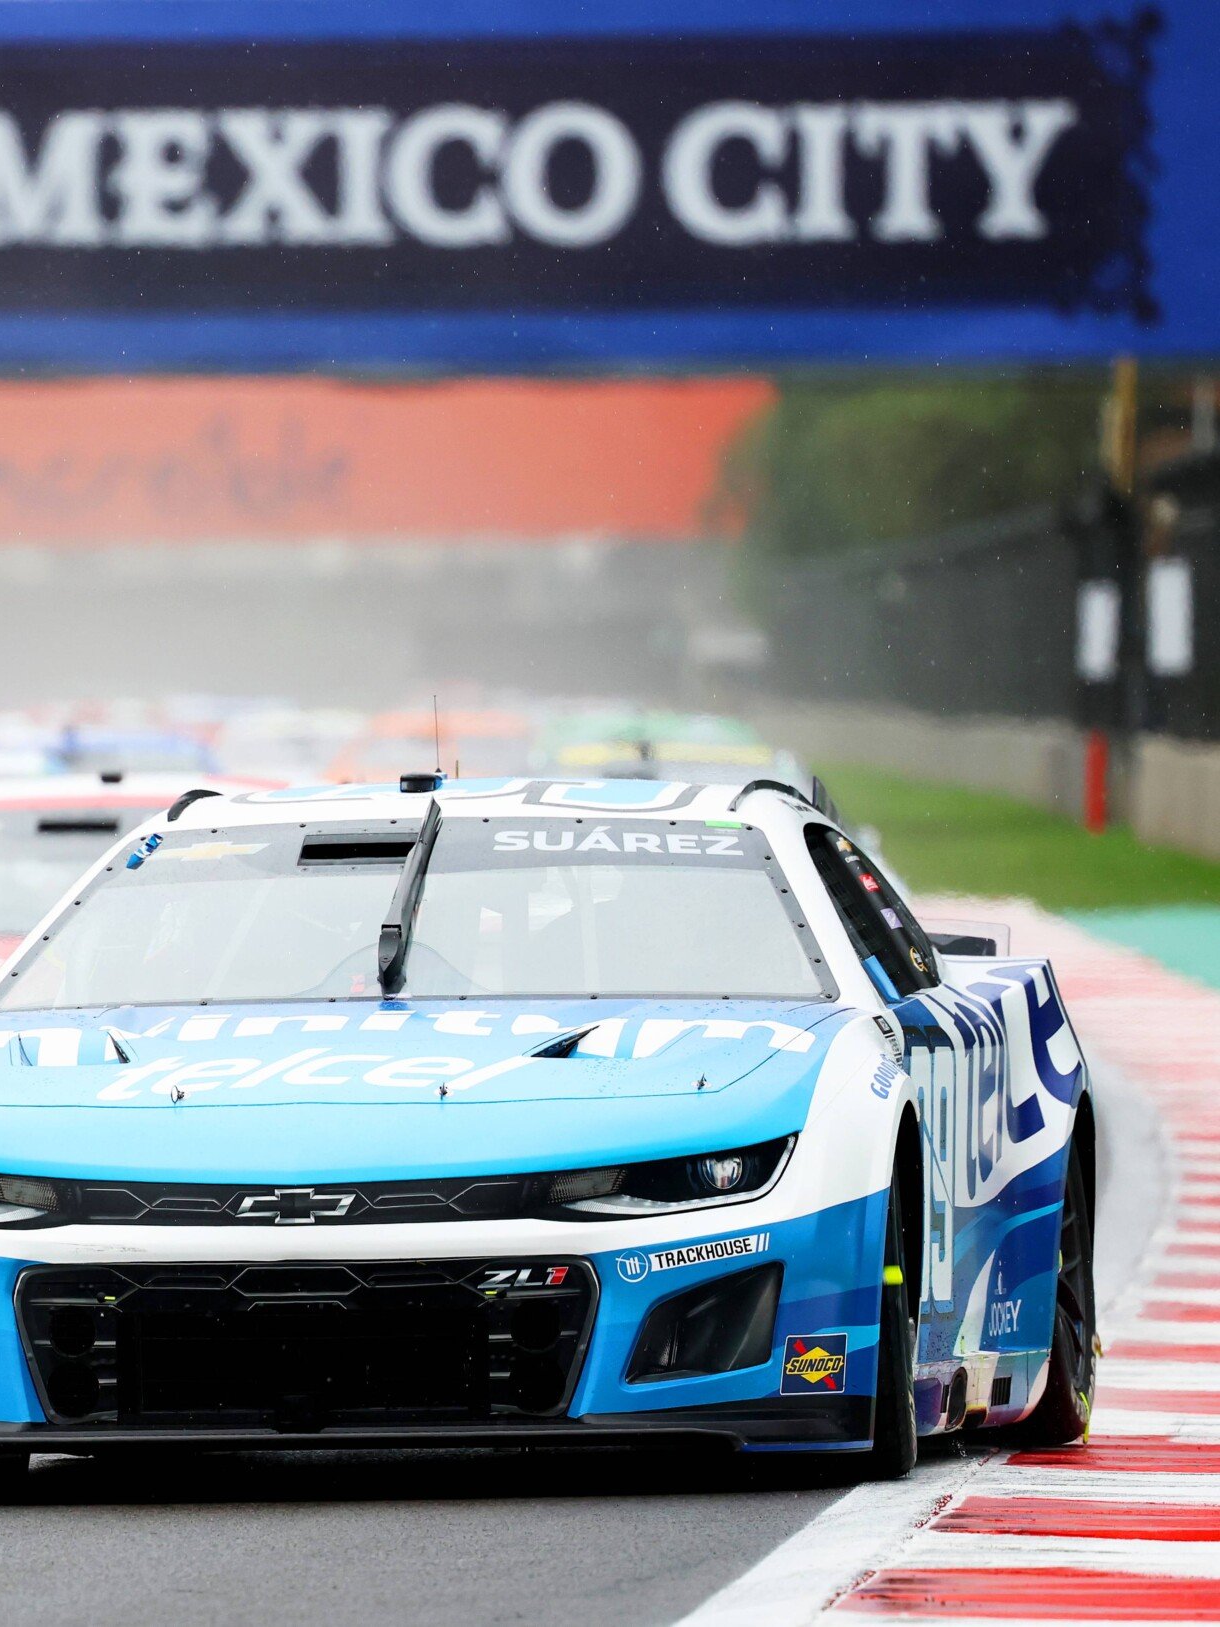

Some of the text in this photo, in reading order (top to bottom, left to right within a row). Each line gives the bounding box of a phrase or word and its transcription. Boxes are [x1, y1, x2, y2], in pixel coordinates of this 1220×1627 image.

[662, 100, 1077, 246] CITY
[492, 826, 745, 857] SUÁREZ
[95, 1046, 544, 1101] telcel
[655, 1238, 753, 1268] TRACKHOUSE
[477, 1266, 569, 1289] ZL1
[786, 1357, 843, 1376] SUNOCO
